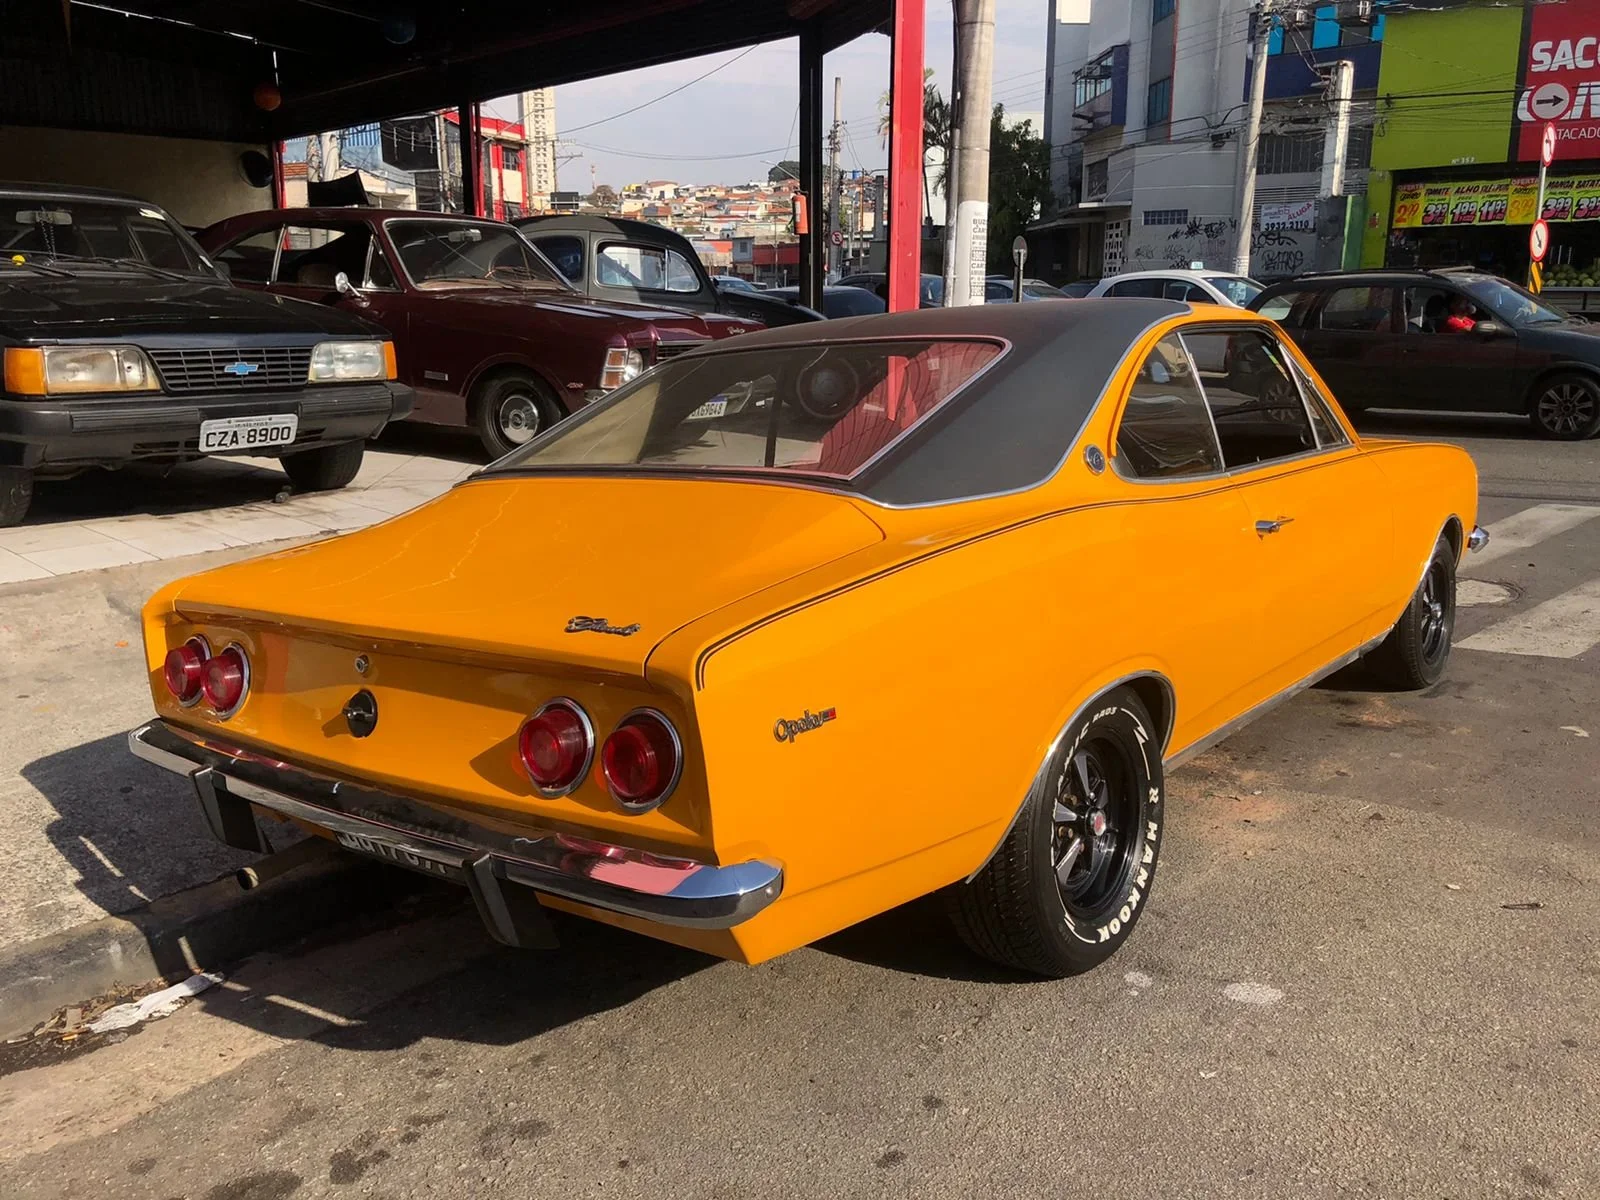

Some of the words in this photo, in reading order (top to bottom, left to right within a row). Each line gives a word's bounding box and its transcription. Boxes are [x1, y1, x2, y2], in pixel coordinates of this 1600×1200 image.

[1531, 37, 1600, 72] SAC
[1554, 126, 1600, 140] TACAD
[1455, 185, 1480, 194] ALHO
[1287, 202, 1313, 221] ALUGA
[205, 426, 292, 448] CZA-8900
[1096, 820, 1158, 943] HANKOOK
